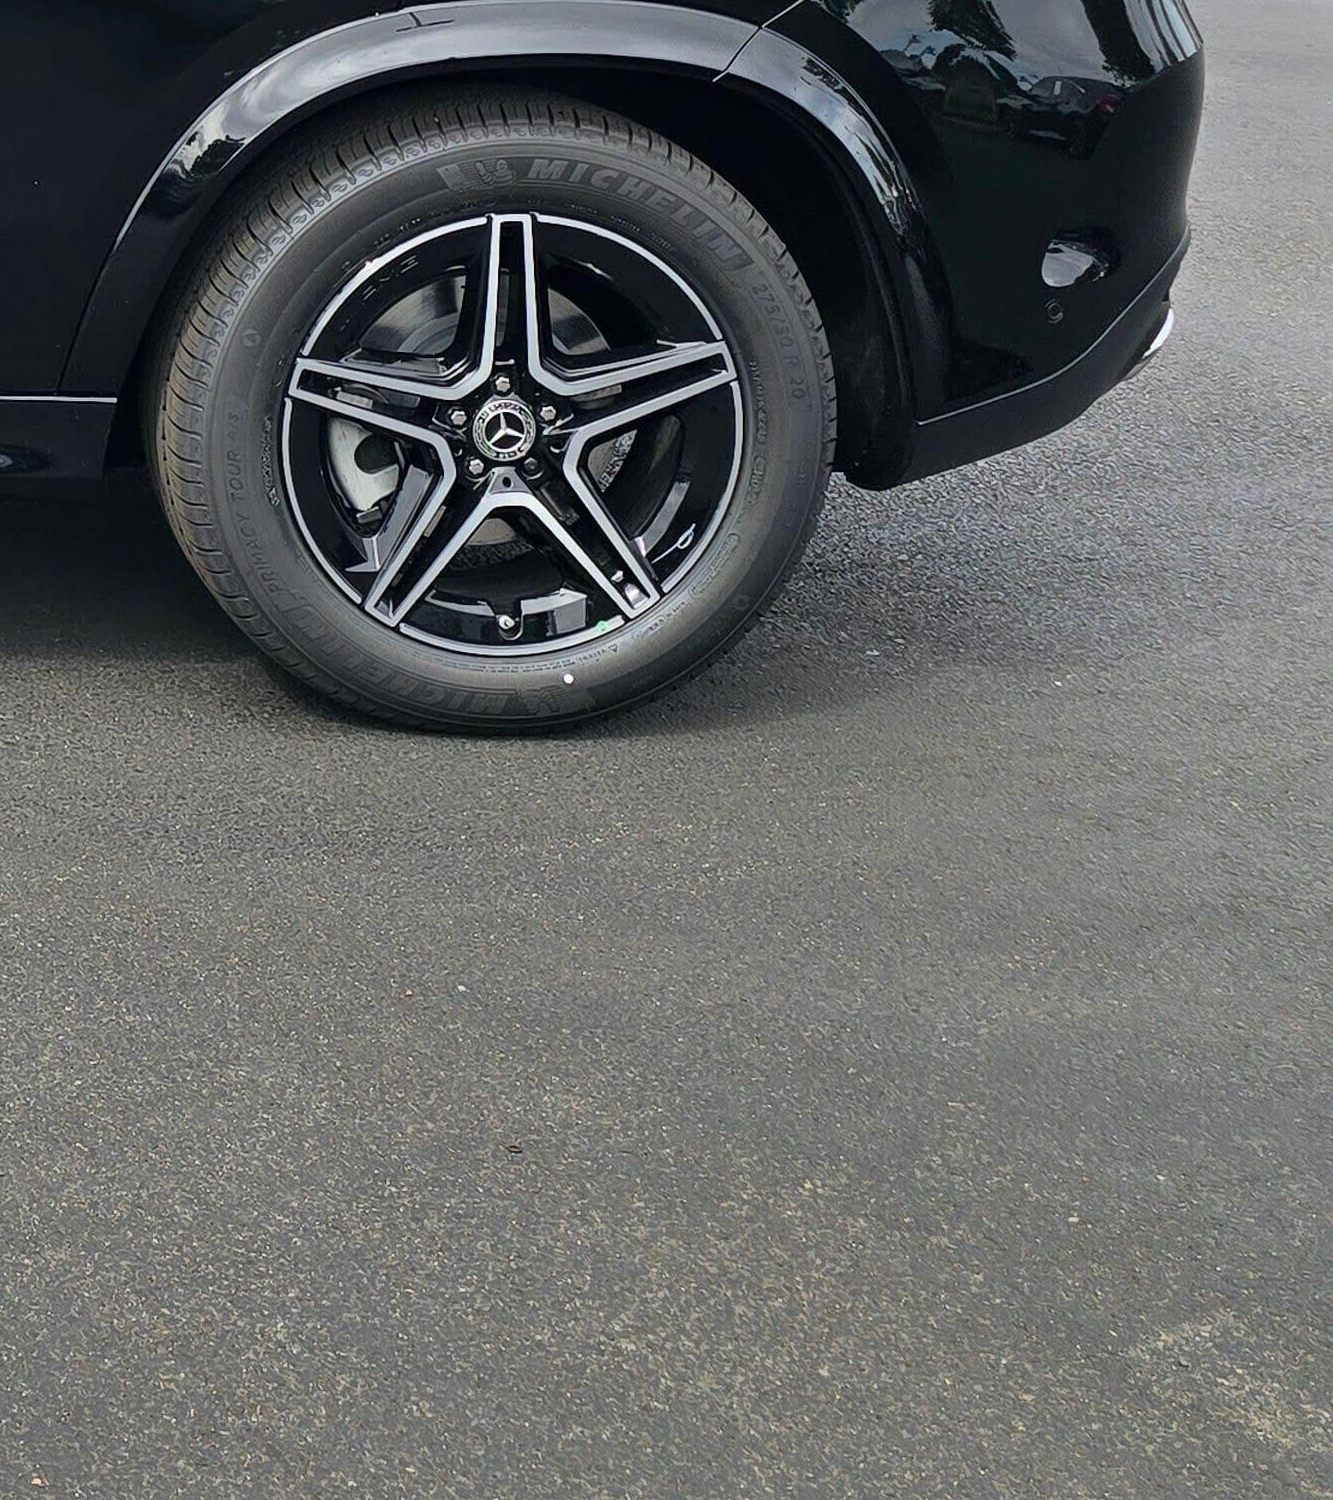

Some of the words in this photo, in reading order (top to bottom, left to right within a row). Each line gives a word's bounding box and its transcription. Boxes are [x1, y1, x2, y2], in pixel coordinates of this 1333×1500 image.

[528, 158, 744, 266] MICHELIN
[226, 451, 245, 502] TOUR
[237, 511, 281, 594] PRIMACY
